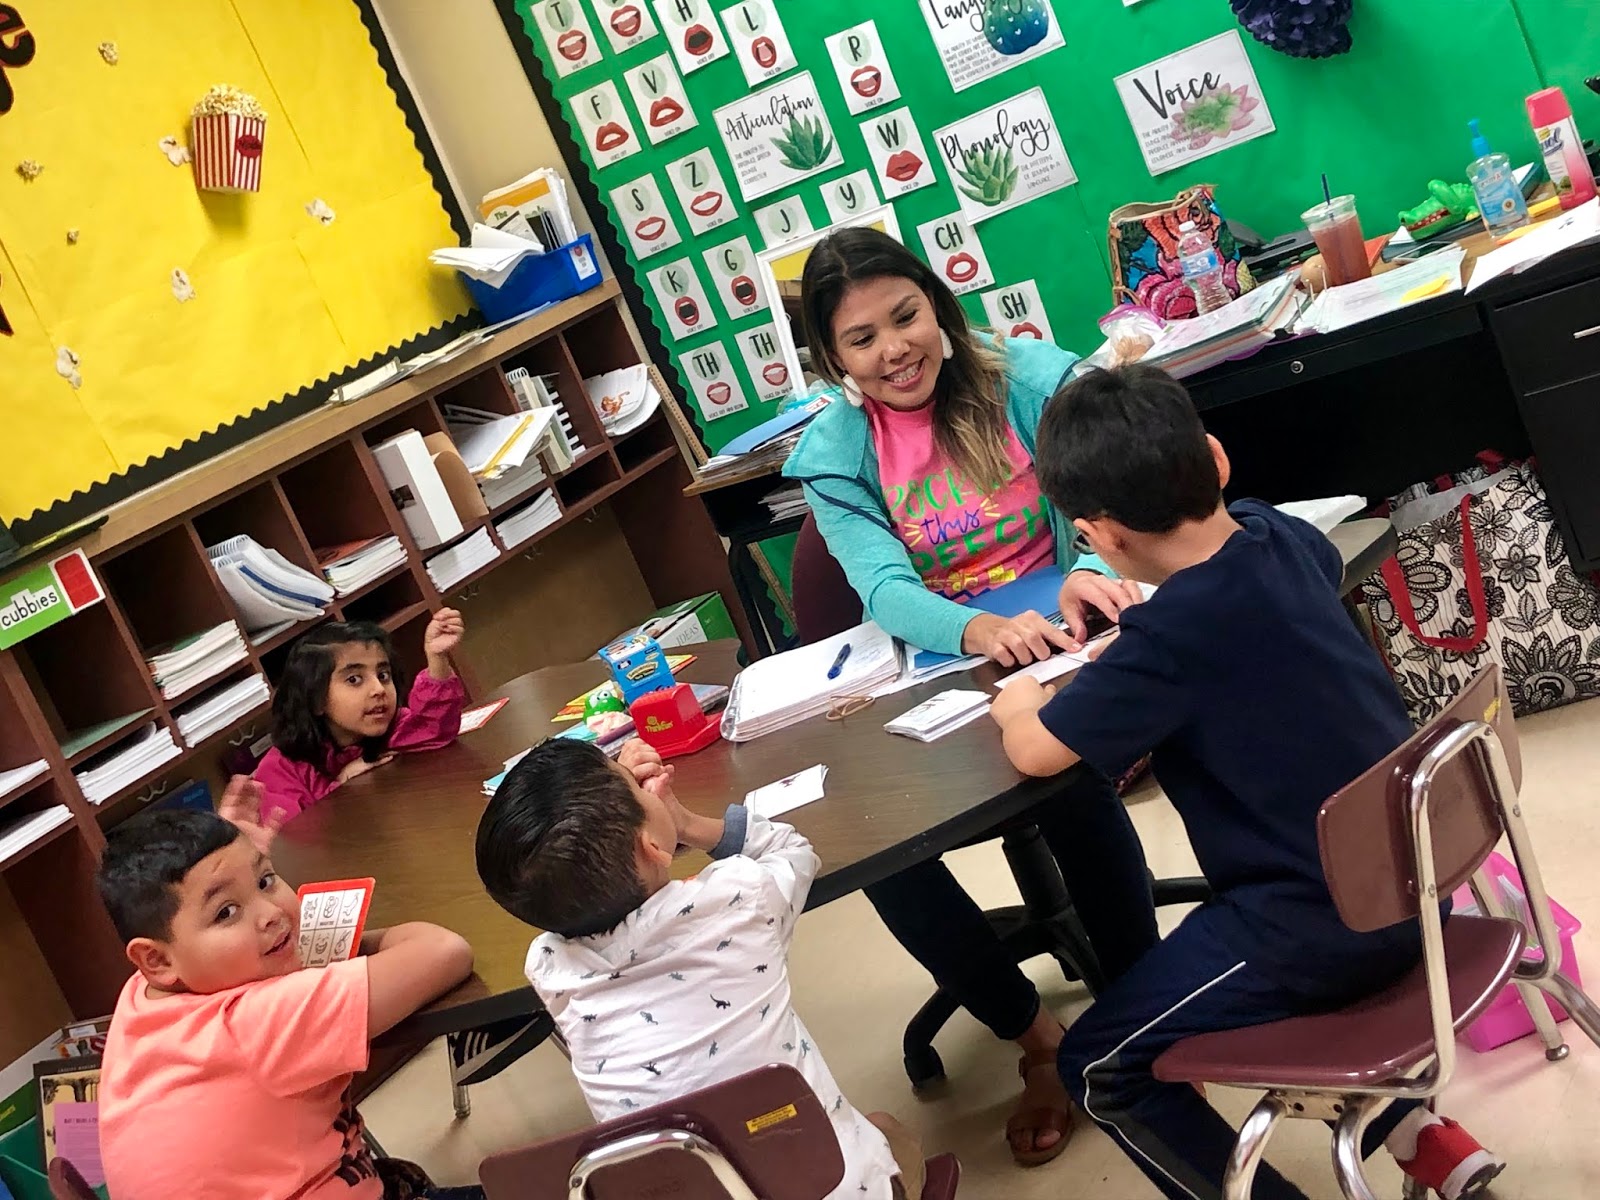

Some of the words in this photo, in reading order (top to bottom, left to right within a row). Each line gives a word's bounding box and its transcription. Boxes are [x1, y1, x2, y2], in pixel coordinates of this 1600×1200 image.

[550, 2, 565, 27] T
[675, 0, 692, 22] H
[742, 6, 758, 31] L
[848, 35, 862, 62] R
[642, 70, 658, 94] V
[1133, 70, 1221, 119] Voice
[590, 95, 602, 120] F
[726, 94, 814, 141] Articulation
[877, 119, 900, 148] W
[940, 109, 1050, 169] Phonology
[684, 161, 703, 188] Z
[632, 188, 644, 211] S
[494, 210, 508, 222] The
[780, 209, 791, 233] J
[935, 222, 963, 250] CH
[724, 248, 738, 271] G
[666, 270, 682, 292] K
[1002, 292, 1027, 320] SH
[749, 332, 776, 358] TH
[692, 352, 720, 378] TH
[908, 495, 1050, 575] PEECH
[922, 508, 980, 545] this
[2, 592, 58, 626] cubbies
[676, 625, 700, 646] IDEAS
